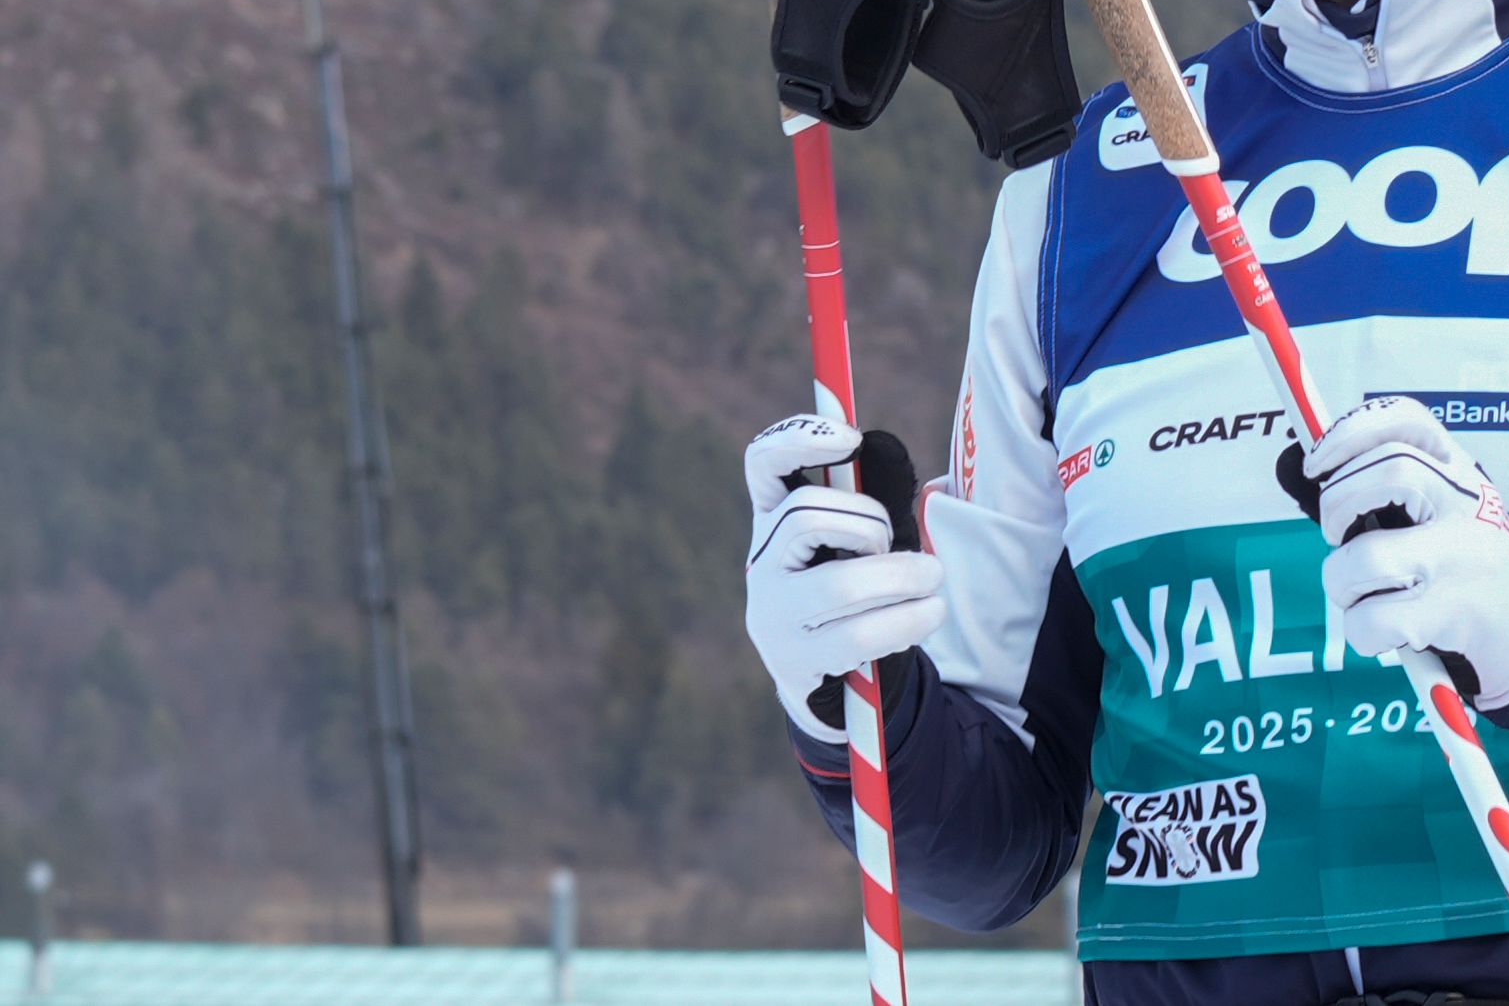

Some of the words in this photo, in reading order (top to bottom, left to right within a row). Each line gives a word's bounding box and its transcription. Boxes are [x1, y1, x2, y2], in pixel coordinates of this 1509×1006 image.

[1149, 409, 1285, 452] CRAFT
[1058, 451, 1092, 485] PAR
[1210, 779, 1257, 819] AS
